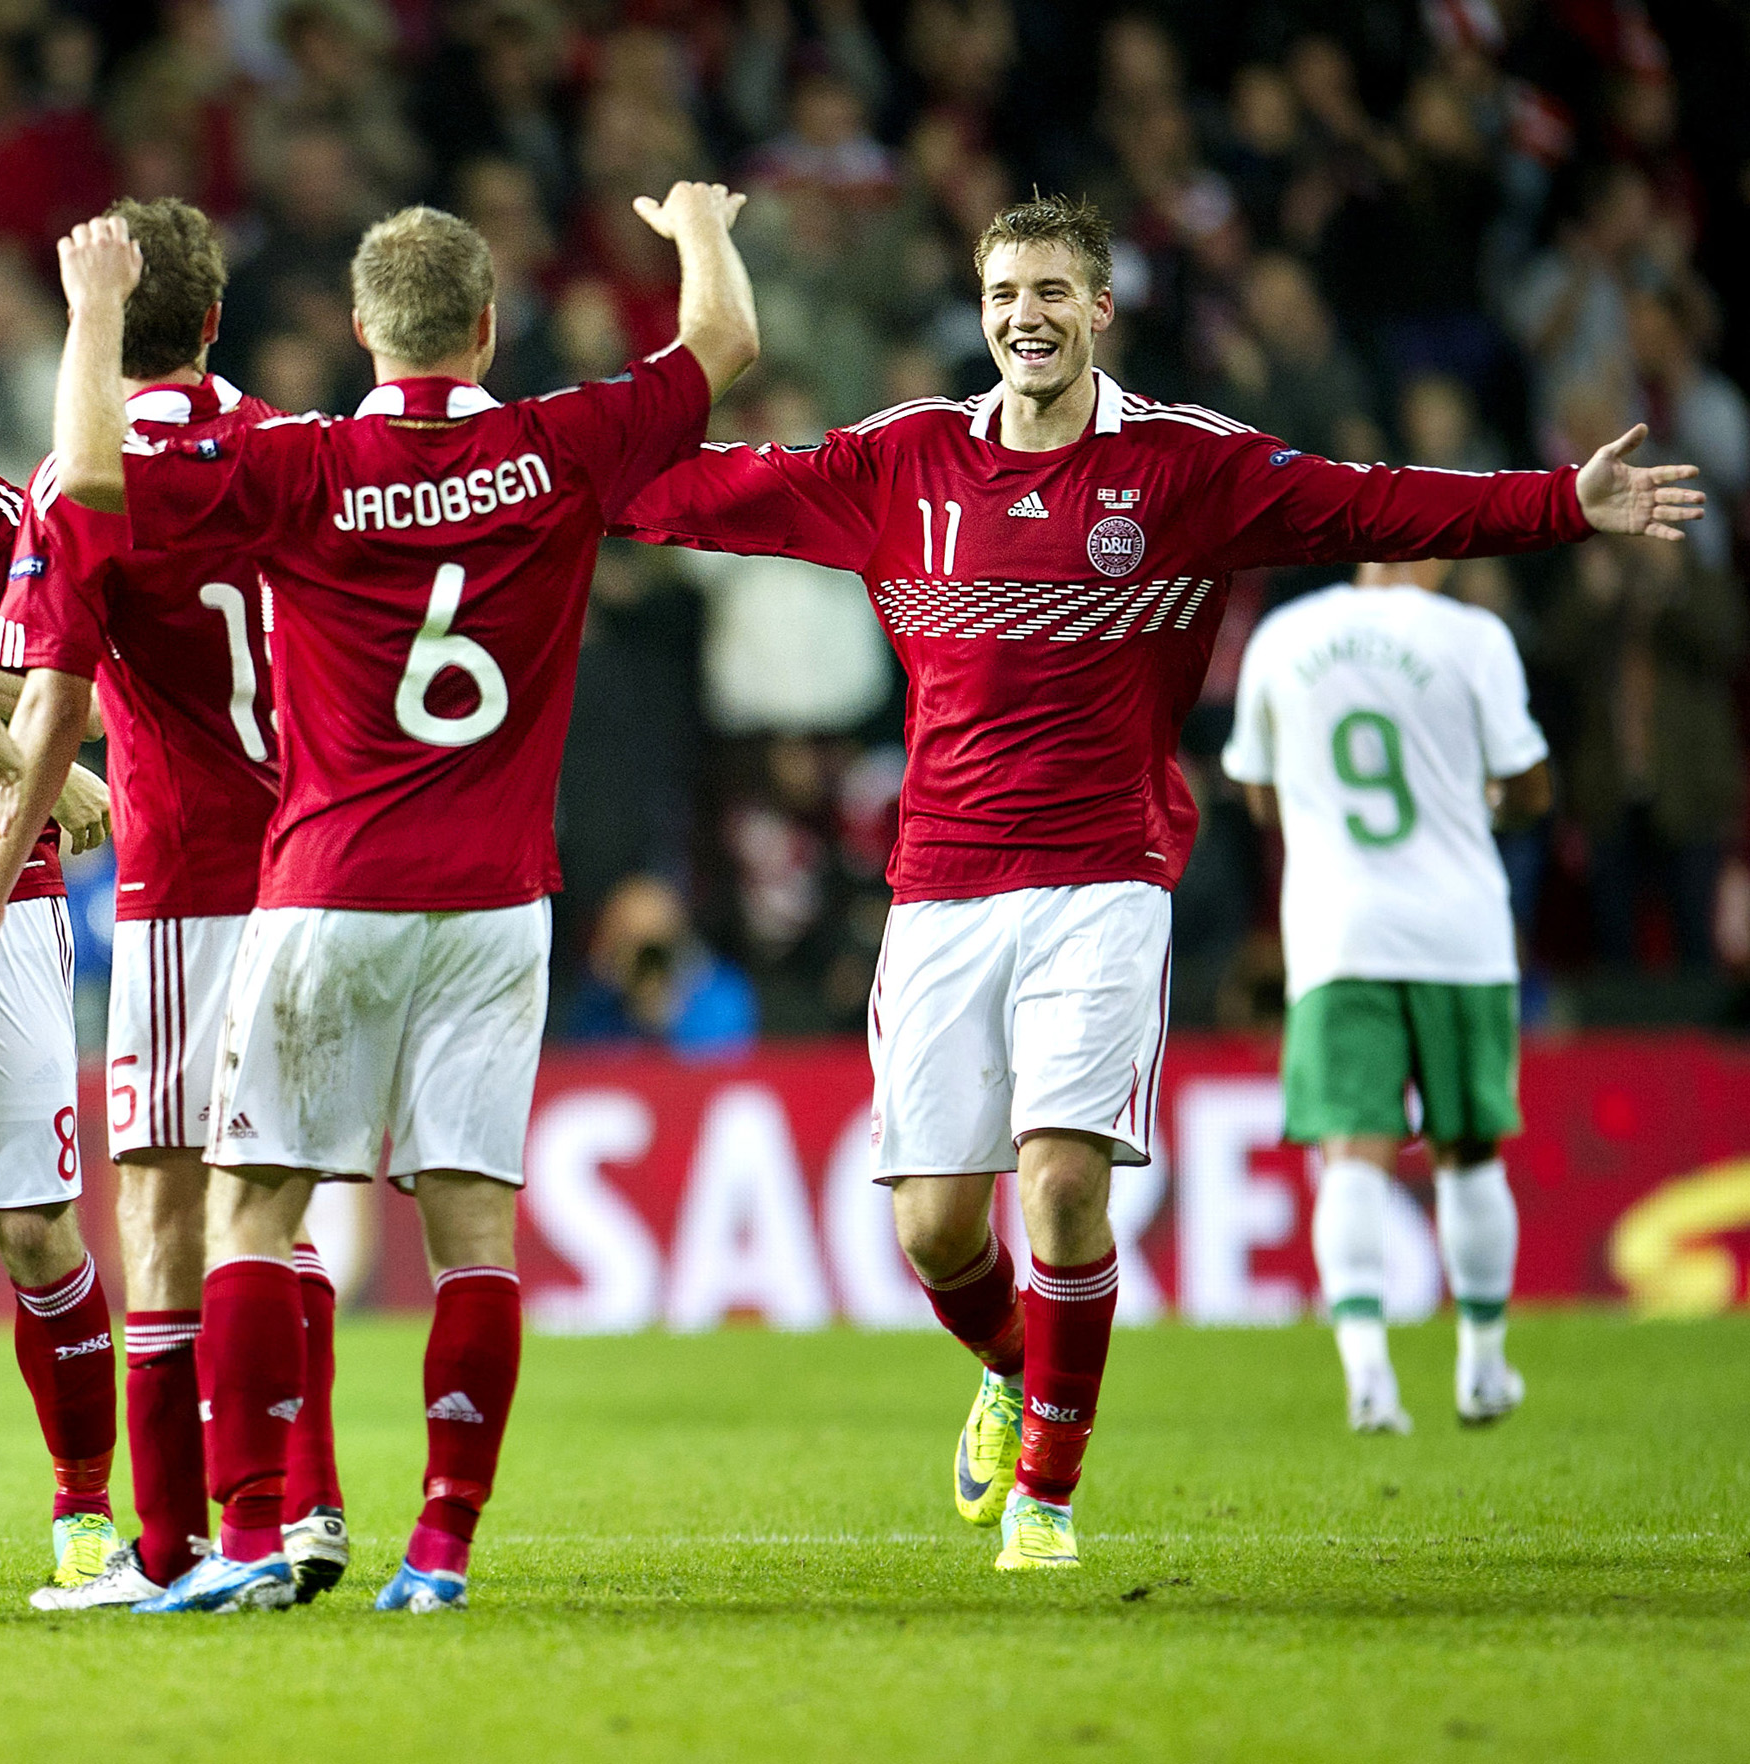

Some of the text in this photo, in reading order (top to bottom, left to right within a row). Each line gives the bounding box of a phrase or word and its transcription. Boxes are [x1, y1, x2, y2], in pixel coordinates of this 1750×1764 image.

[333, 453, 552, 532] JACOBSEN
[1008, 504, 1049, 519] adidas
[918, 498, 962, 576] 11
[1100, 536, 1133, 555] DBU
[199, 582, 280, 762] 1
[394, 562, 508, 747] 6
[1332, 710, 1418, 849] 9
[54, 1105, 76, 1182] 8
[427, 1408, 484, 1424] adidas
[1030, 1395, 1080, 1422] DBU
